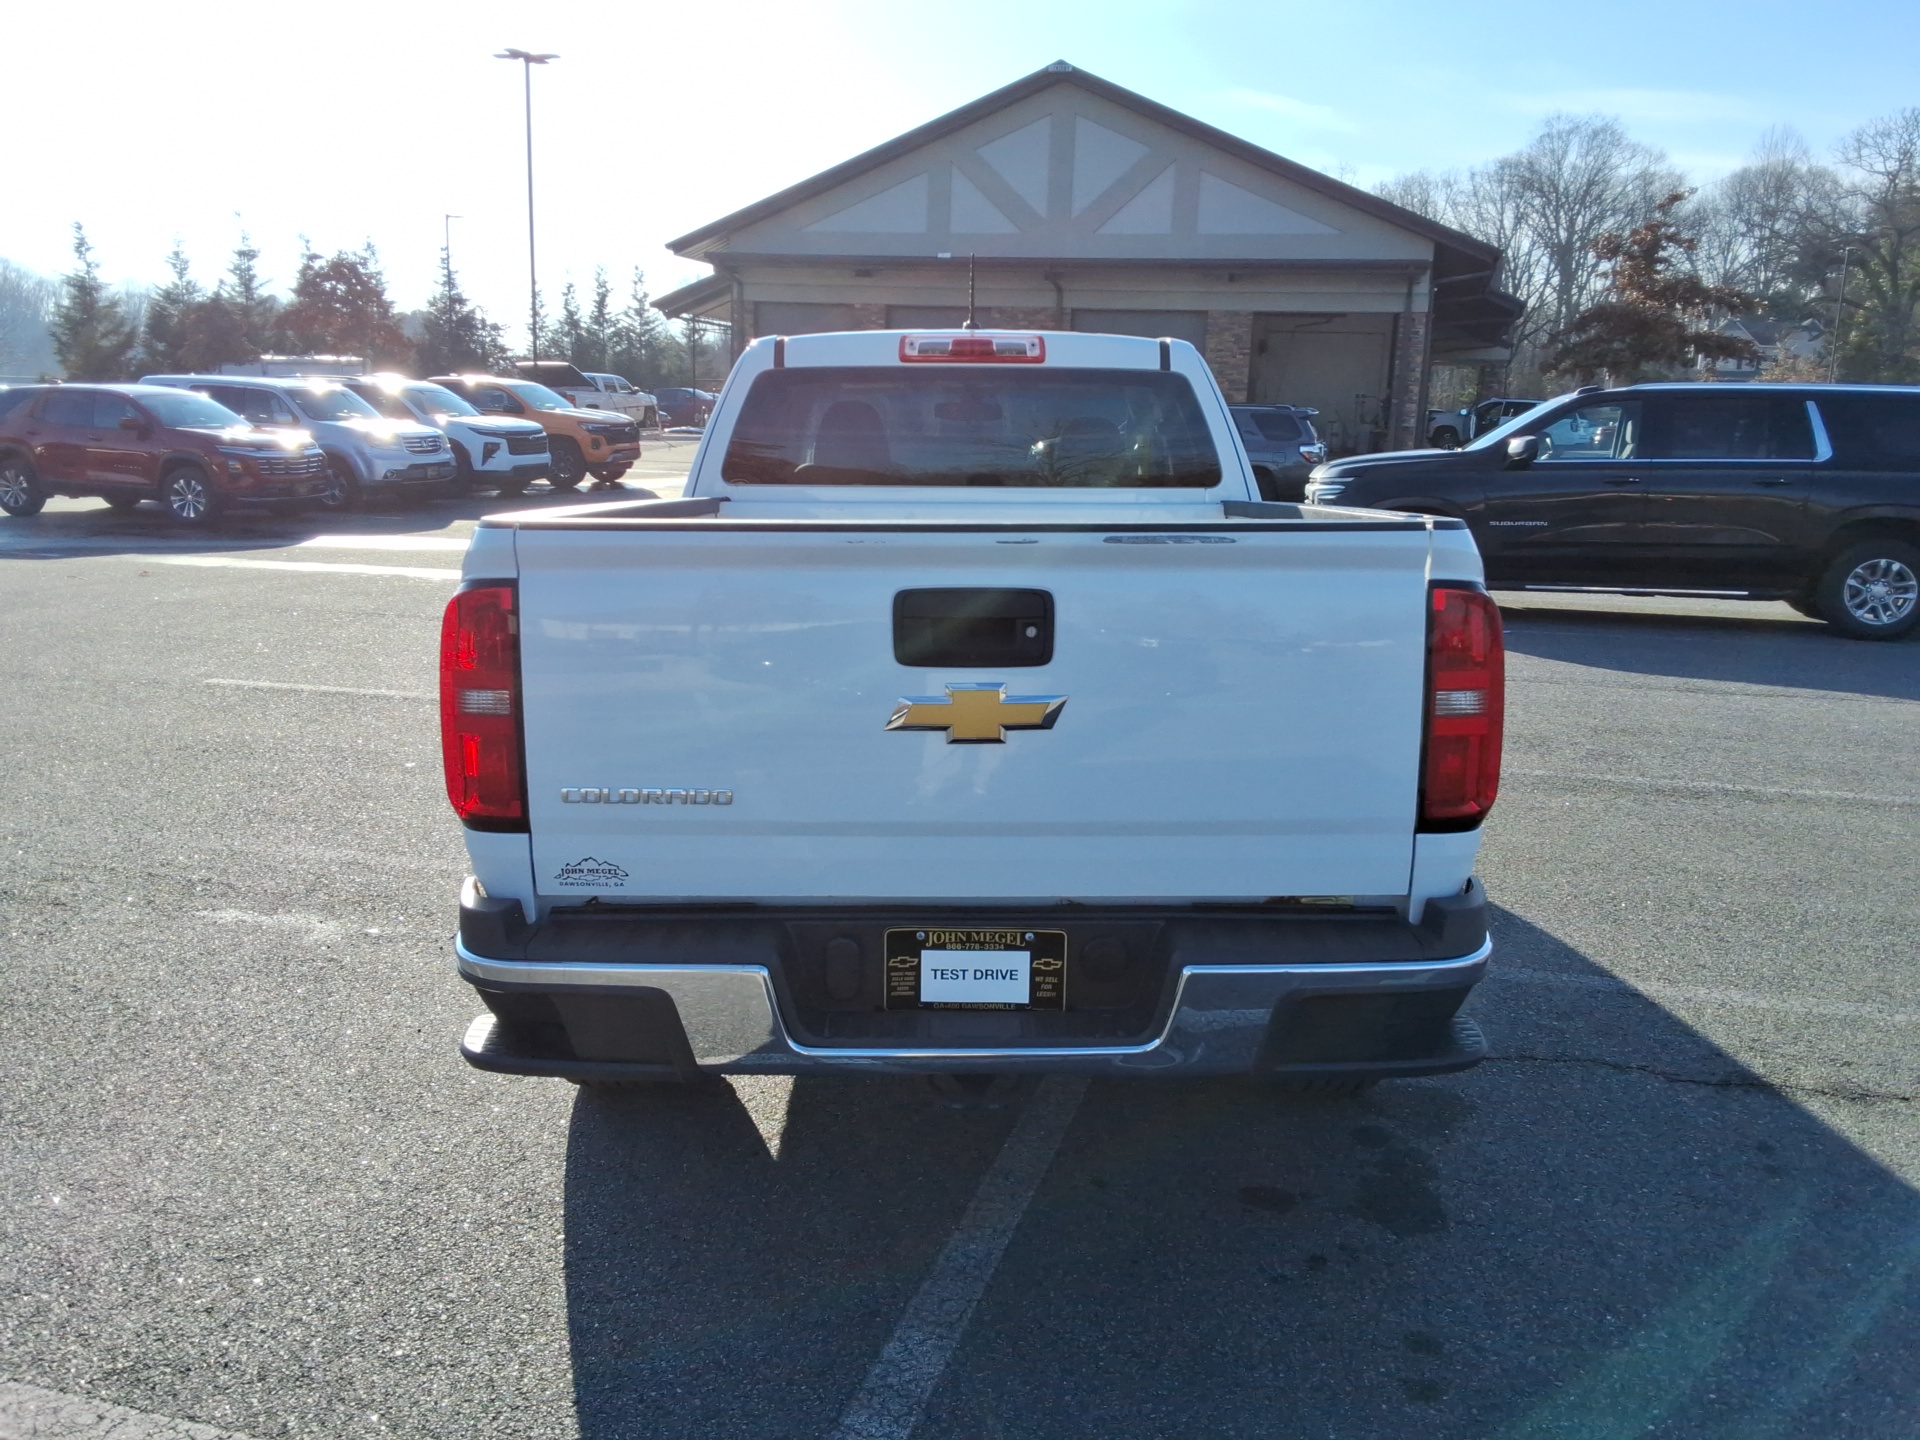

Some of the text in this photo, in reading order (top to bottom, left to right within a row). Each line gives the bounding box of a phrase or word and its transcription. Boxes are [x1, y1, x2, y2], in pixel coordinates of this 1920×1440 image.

[560, 787, 733, 806] COLORADO
[560, 868, 620, 877] JOHN MEGEL
[926, 931, 1026, 948] JOHN MEGEL
[931, 968, 1019, 981] TEST DRIVE
